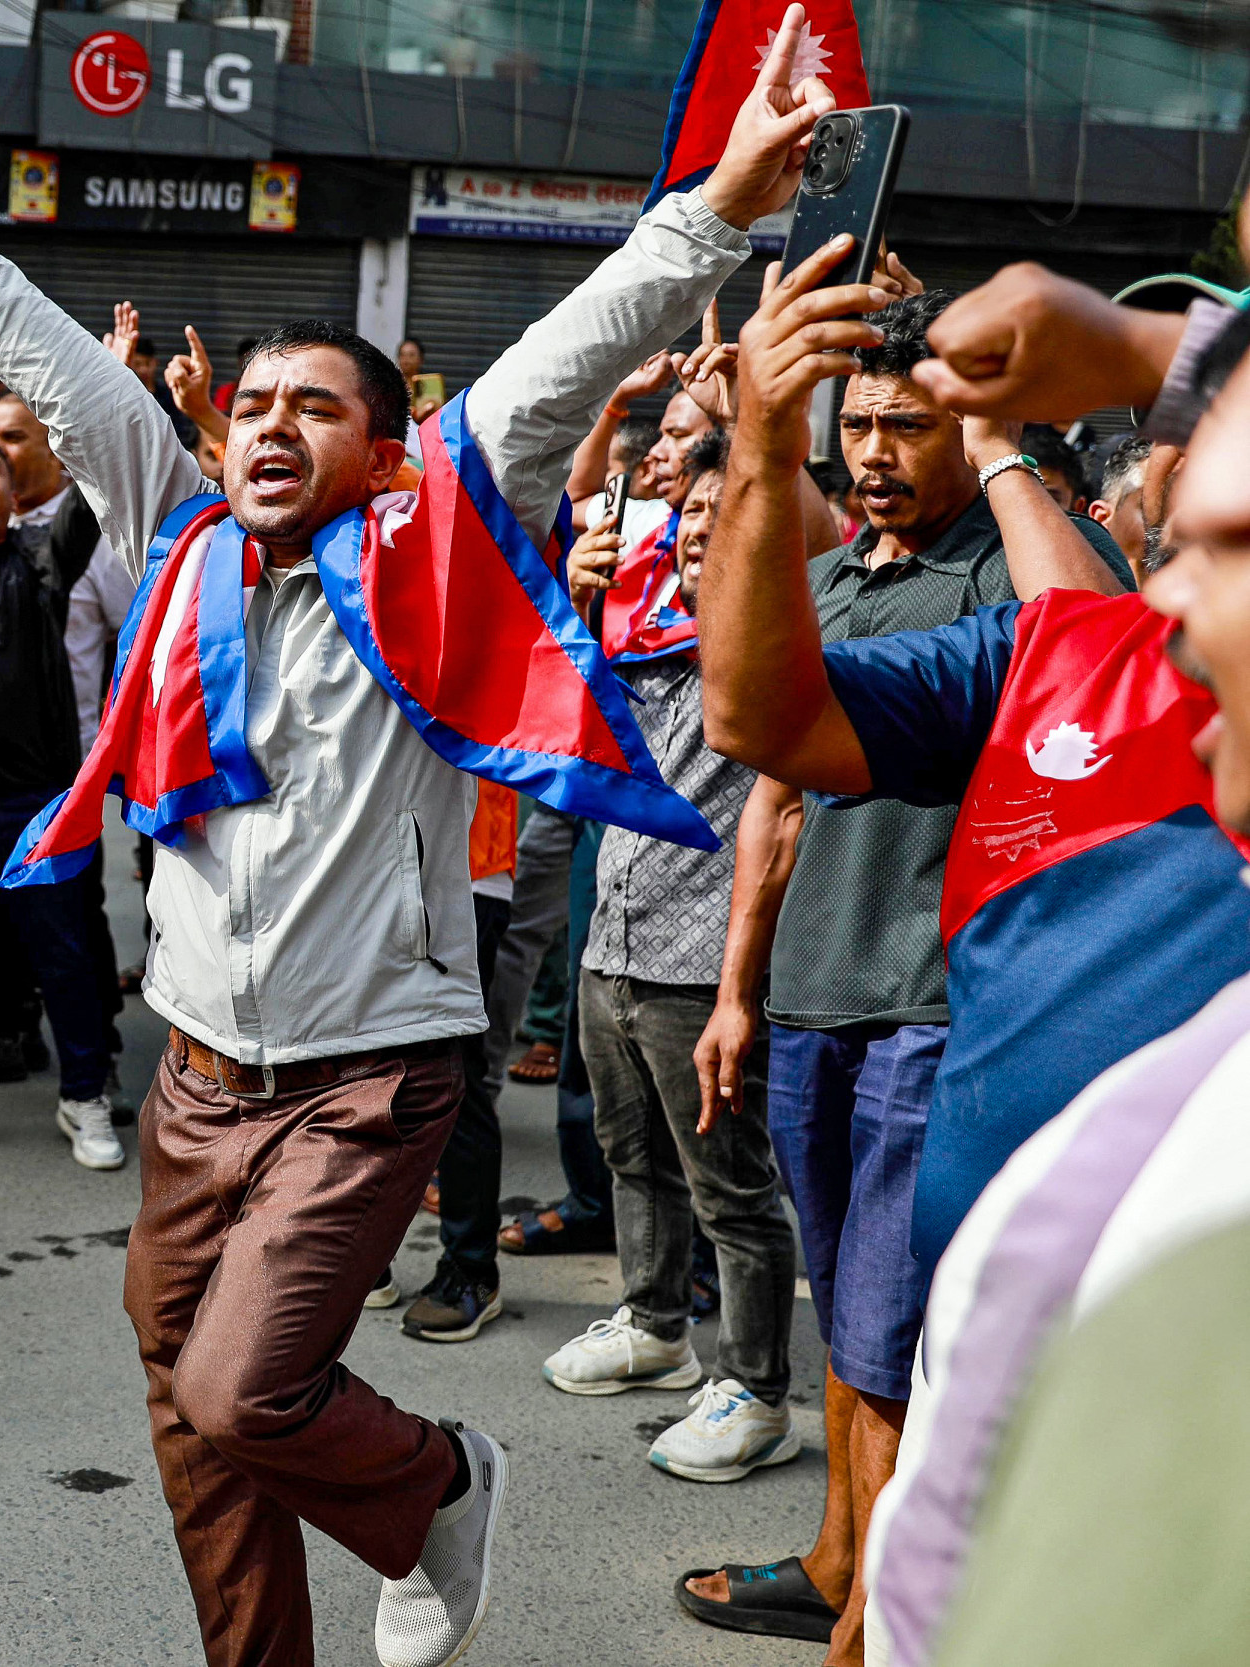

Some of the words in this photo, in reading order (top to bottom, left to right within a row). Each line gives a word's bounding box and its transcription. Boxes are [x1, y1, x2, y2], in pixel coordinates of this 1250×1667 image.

[165, 49, 253, 113] LG
[85, 177, 244, 211] SAMSUNG
[461, 175, 476, 195] A
